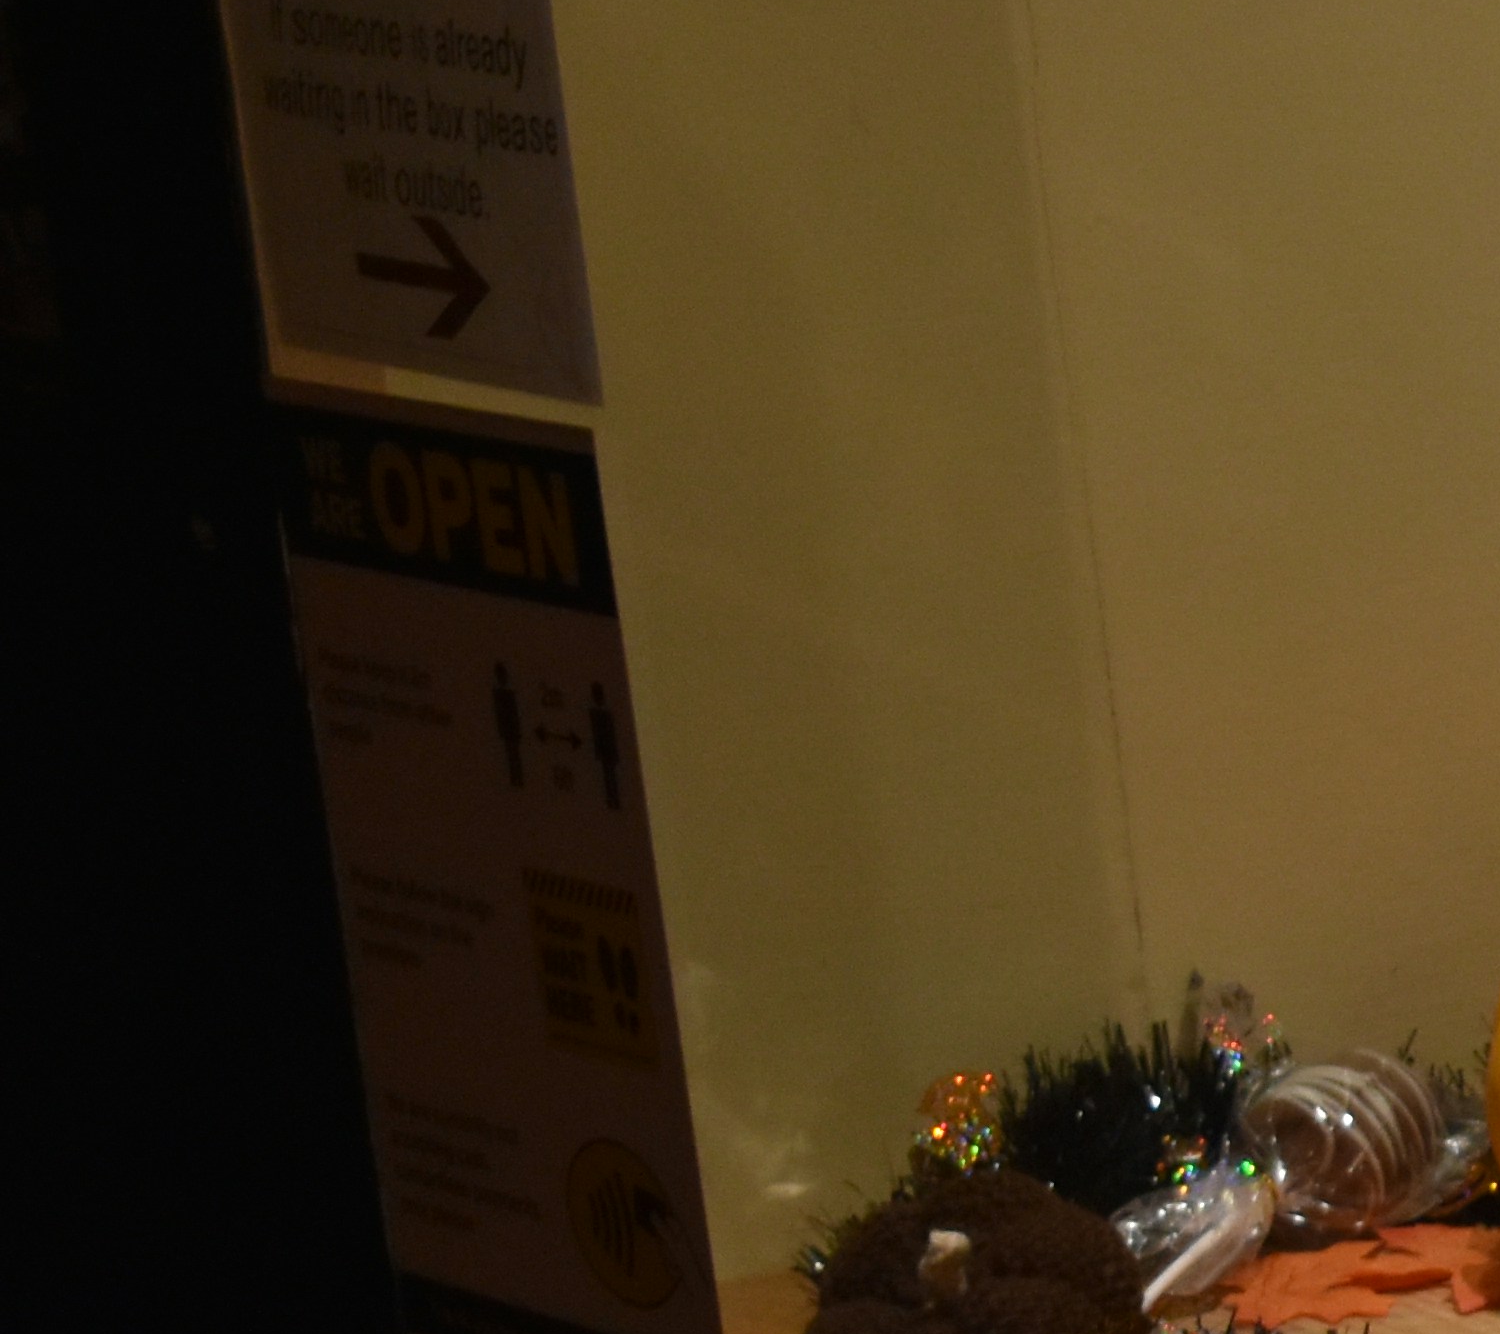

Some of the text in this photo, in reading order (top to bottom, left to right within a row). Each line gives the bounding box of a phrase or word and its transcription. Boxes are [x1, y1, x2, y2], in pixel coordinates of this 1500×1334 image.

[291, 10, 402, 57] someone
[432, 20, 531, 89] already
[262, 70, 346, 130] waiting
[375, 85, 418, 132] the
[424, 93, 467, 140] box
[471, 100, 559, 161] please
[342, 153, 388, 202] wait
[363, 438, 580, 588] OPEN
